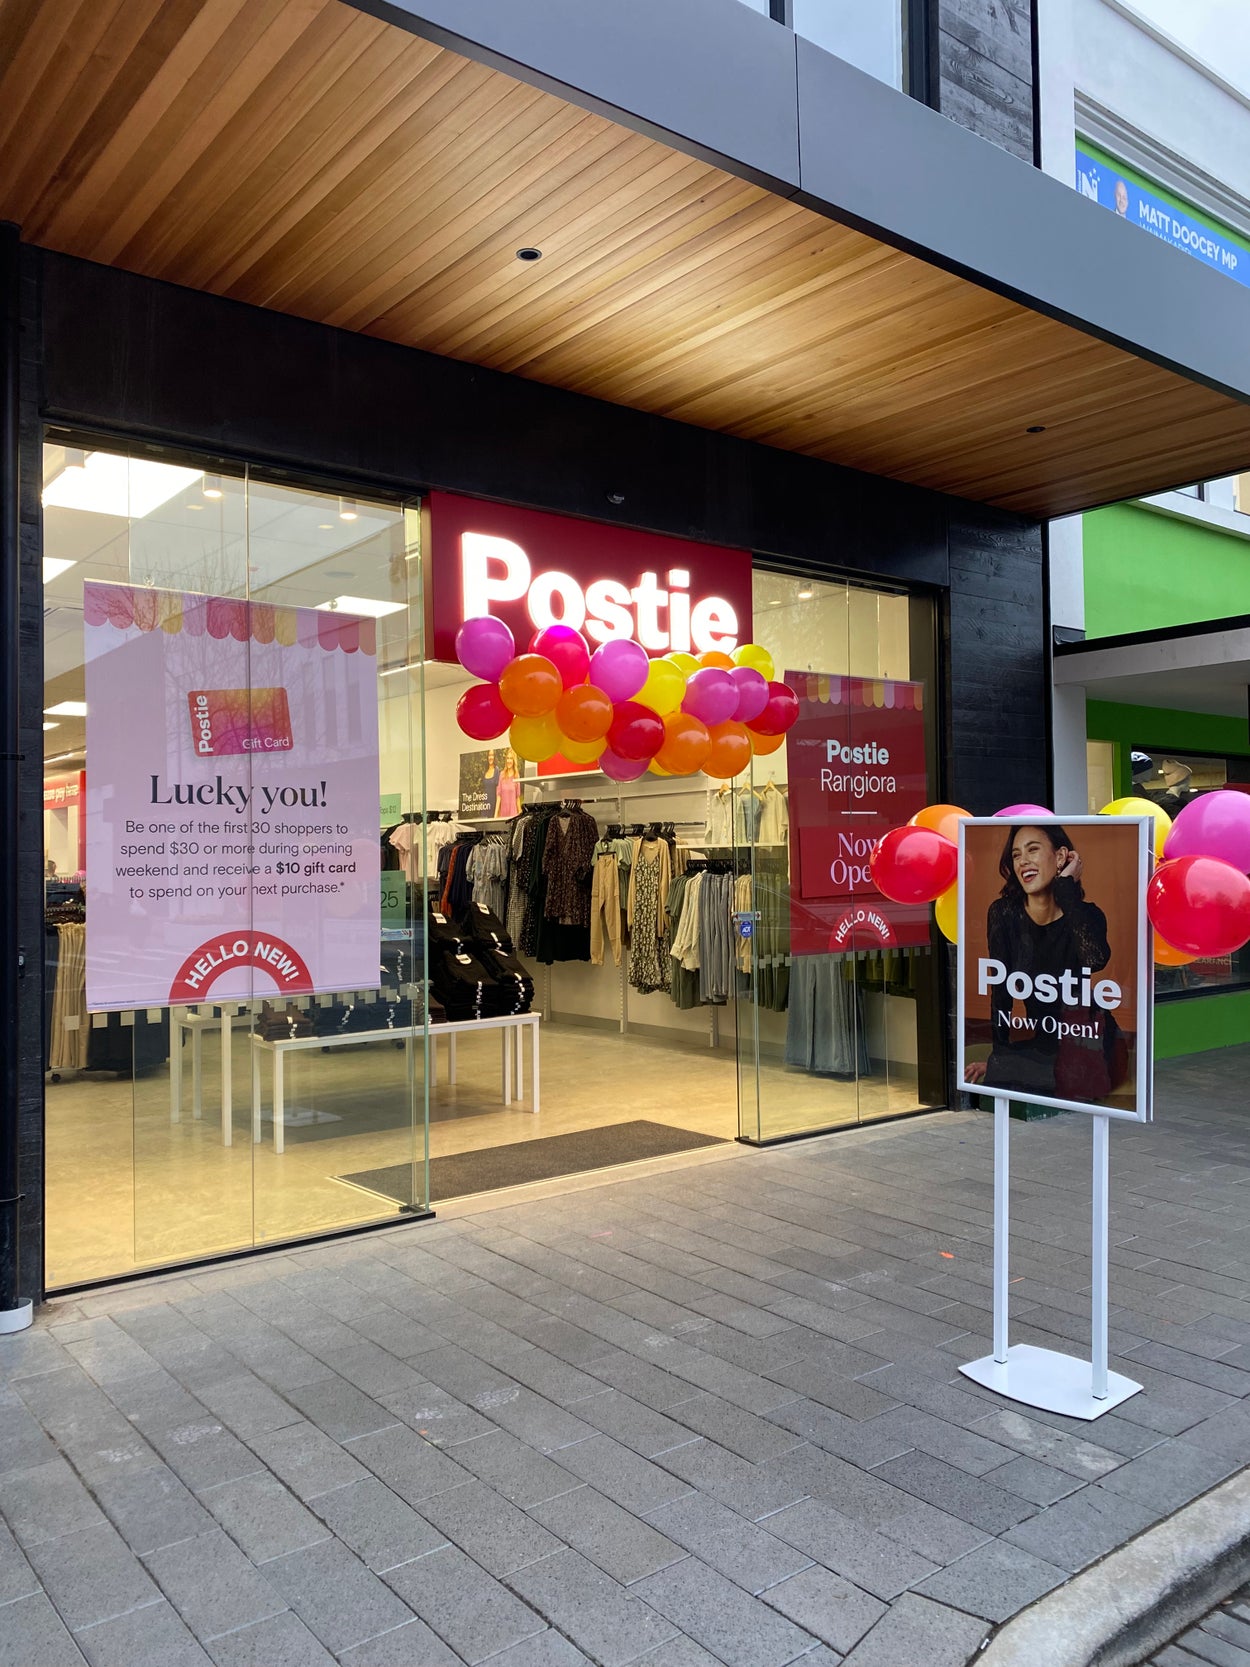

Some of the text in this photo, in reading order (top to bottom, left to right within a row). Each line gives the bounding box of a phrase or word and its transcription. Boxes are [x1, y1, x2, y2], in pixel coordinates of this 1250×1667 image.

[1139, 200, 1170, 233] MATT
[1172, 219, 1220, 262] DOOCEY
[1222, 248, 1238, 271] MP
[461, 531, 739, 655] Postie
[194, 694, 214, 754] Postie
[242, 736, 290, 750] Gift Card
[826, 739, 890, 765] Postie
[150, 774, 328, 814] Lucky you!
[462, 792, 488, 802] The Dress
[820, 768, 897, 799] Rangiora
[461, 802, 491, 812] Destination
[125, 820, 349, 837] Be one of the first 30 shoppers to
[120, 841, 353, 857] spend $30 or more during opening
[115, 861, 356, 877] weekend and receive a $10 gift card
[830, 858, 873, 891] Ope
[129, 887, 145, 899] to
[148, 884, 192, 899] spend
[196, 886, 214, 898] on
[218, 885, 247, 899] your
[251, 883, 278, 896] next
[835, 910, 891, 944] HELLO NEW!
[184, 940, 300, 989] HELLO NEW!
[977, 957, 1122, 1011] Postie
[997, 1009, 1100, 1040] Now Open!
